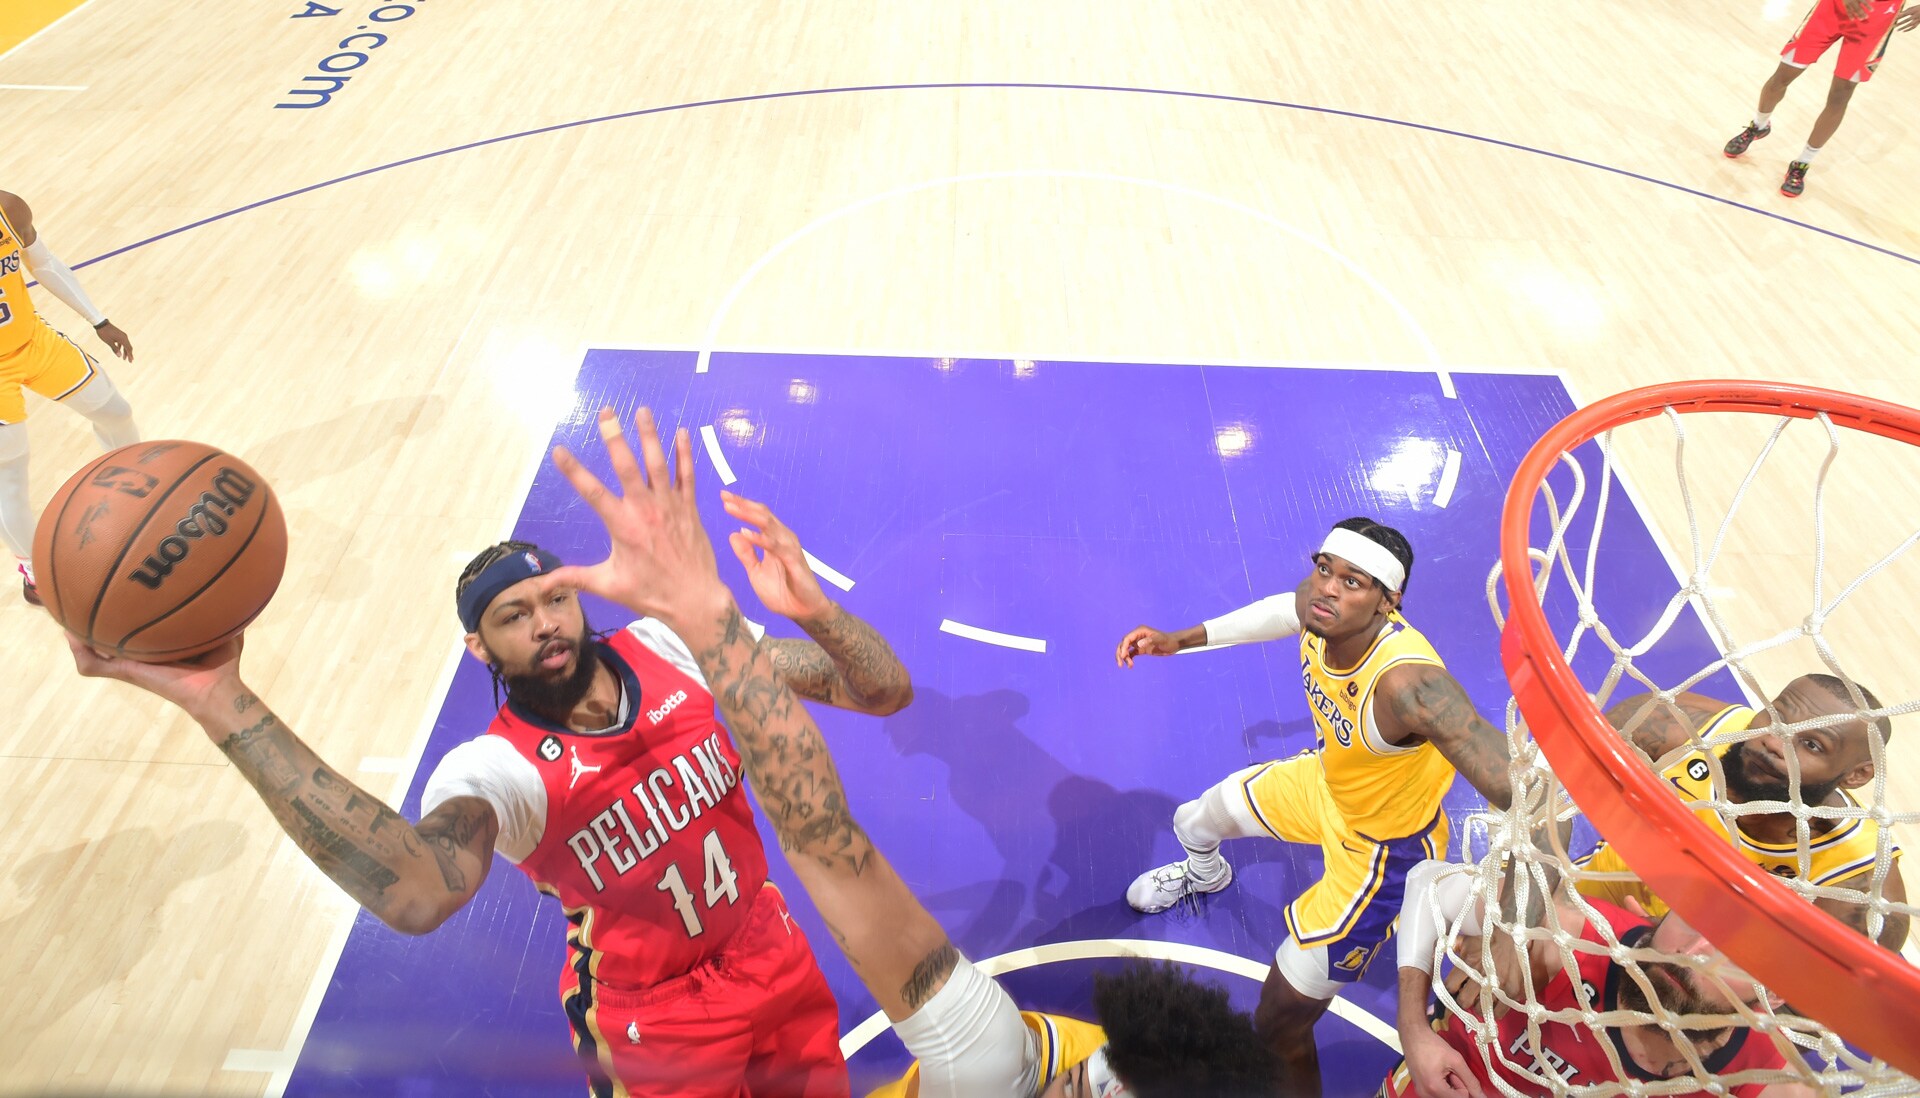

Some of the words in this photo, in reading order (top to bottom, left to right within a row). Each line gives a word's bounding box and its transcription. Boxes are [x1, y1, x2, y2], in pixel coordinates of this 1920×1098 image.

[289, 1, 343, 19] A
[272, 0, 426, 109] o.com
[128, 467, 256, 591] Wilson
[646, 689, 688, 726] ibotta
[1301, 653, 1354, 749] LAKERS
[1339, 689, 1357, 712] bibigo
[540, 737, 562, 761] 6
[1688, 761, 1708, 780] 6
[566, 731, 737, 893] PELICANS
[656, 828, 739, 938] 14
